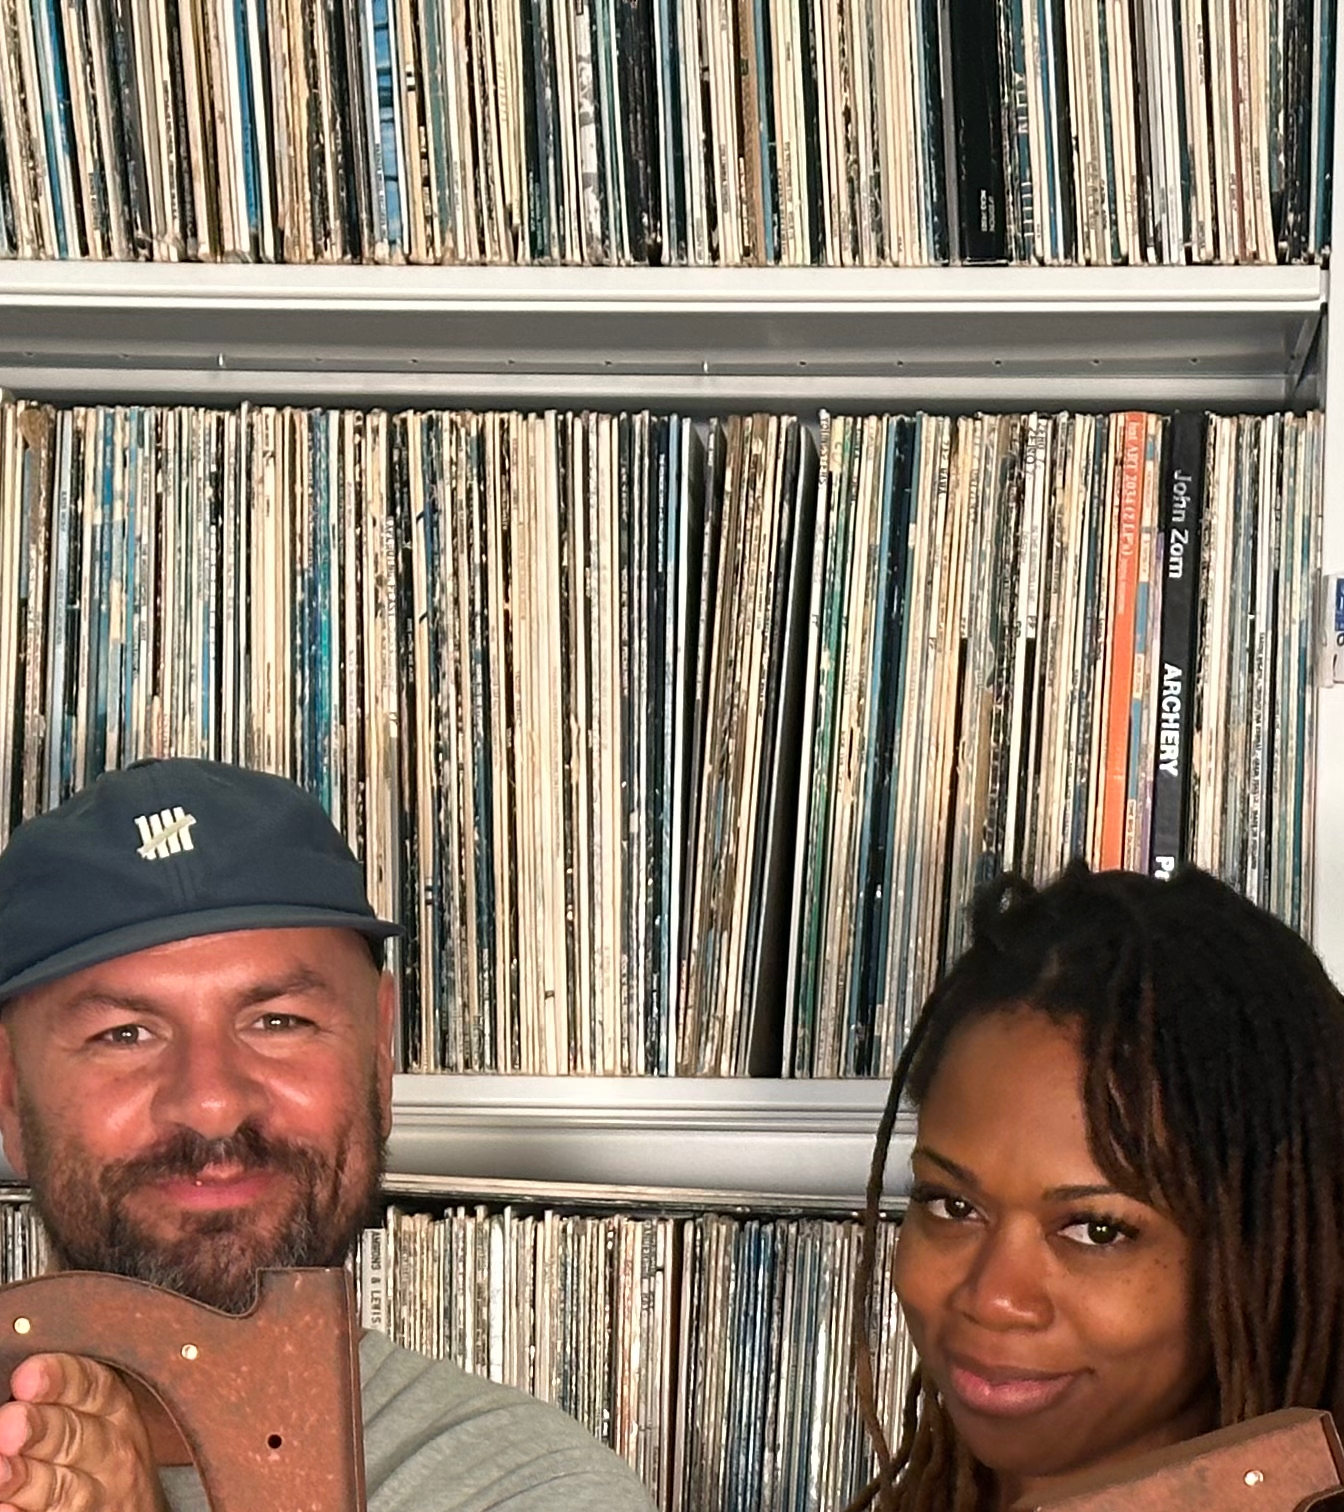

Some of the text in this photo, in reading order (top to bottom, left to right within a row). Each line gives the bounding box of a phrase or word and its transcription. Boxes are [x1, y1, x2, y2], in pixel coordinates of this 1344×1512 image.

[1125, 446, 1139, 470] ART
[1172, 469, 1192, 522] John
[1159, 663, 1182, 777] ARCHERY
[370, 1289, 382, 1324] LEWIS
